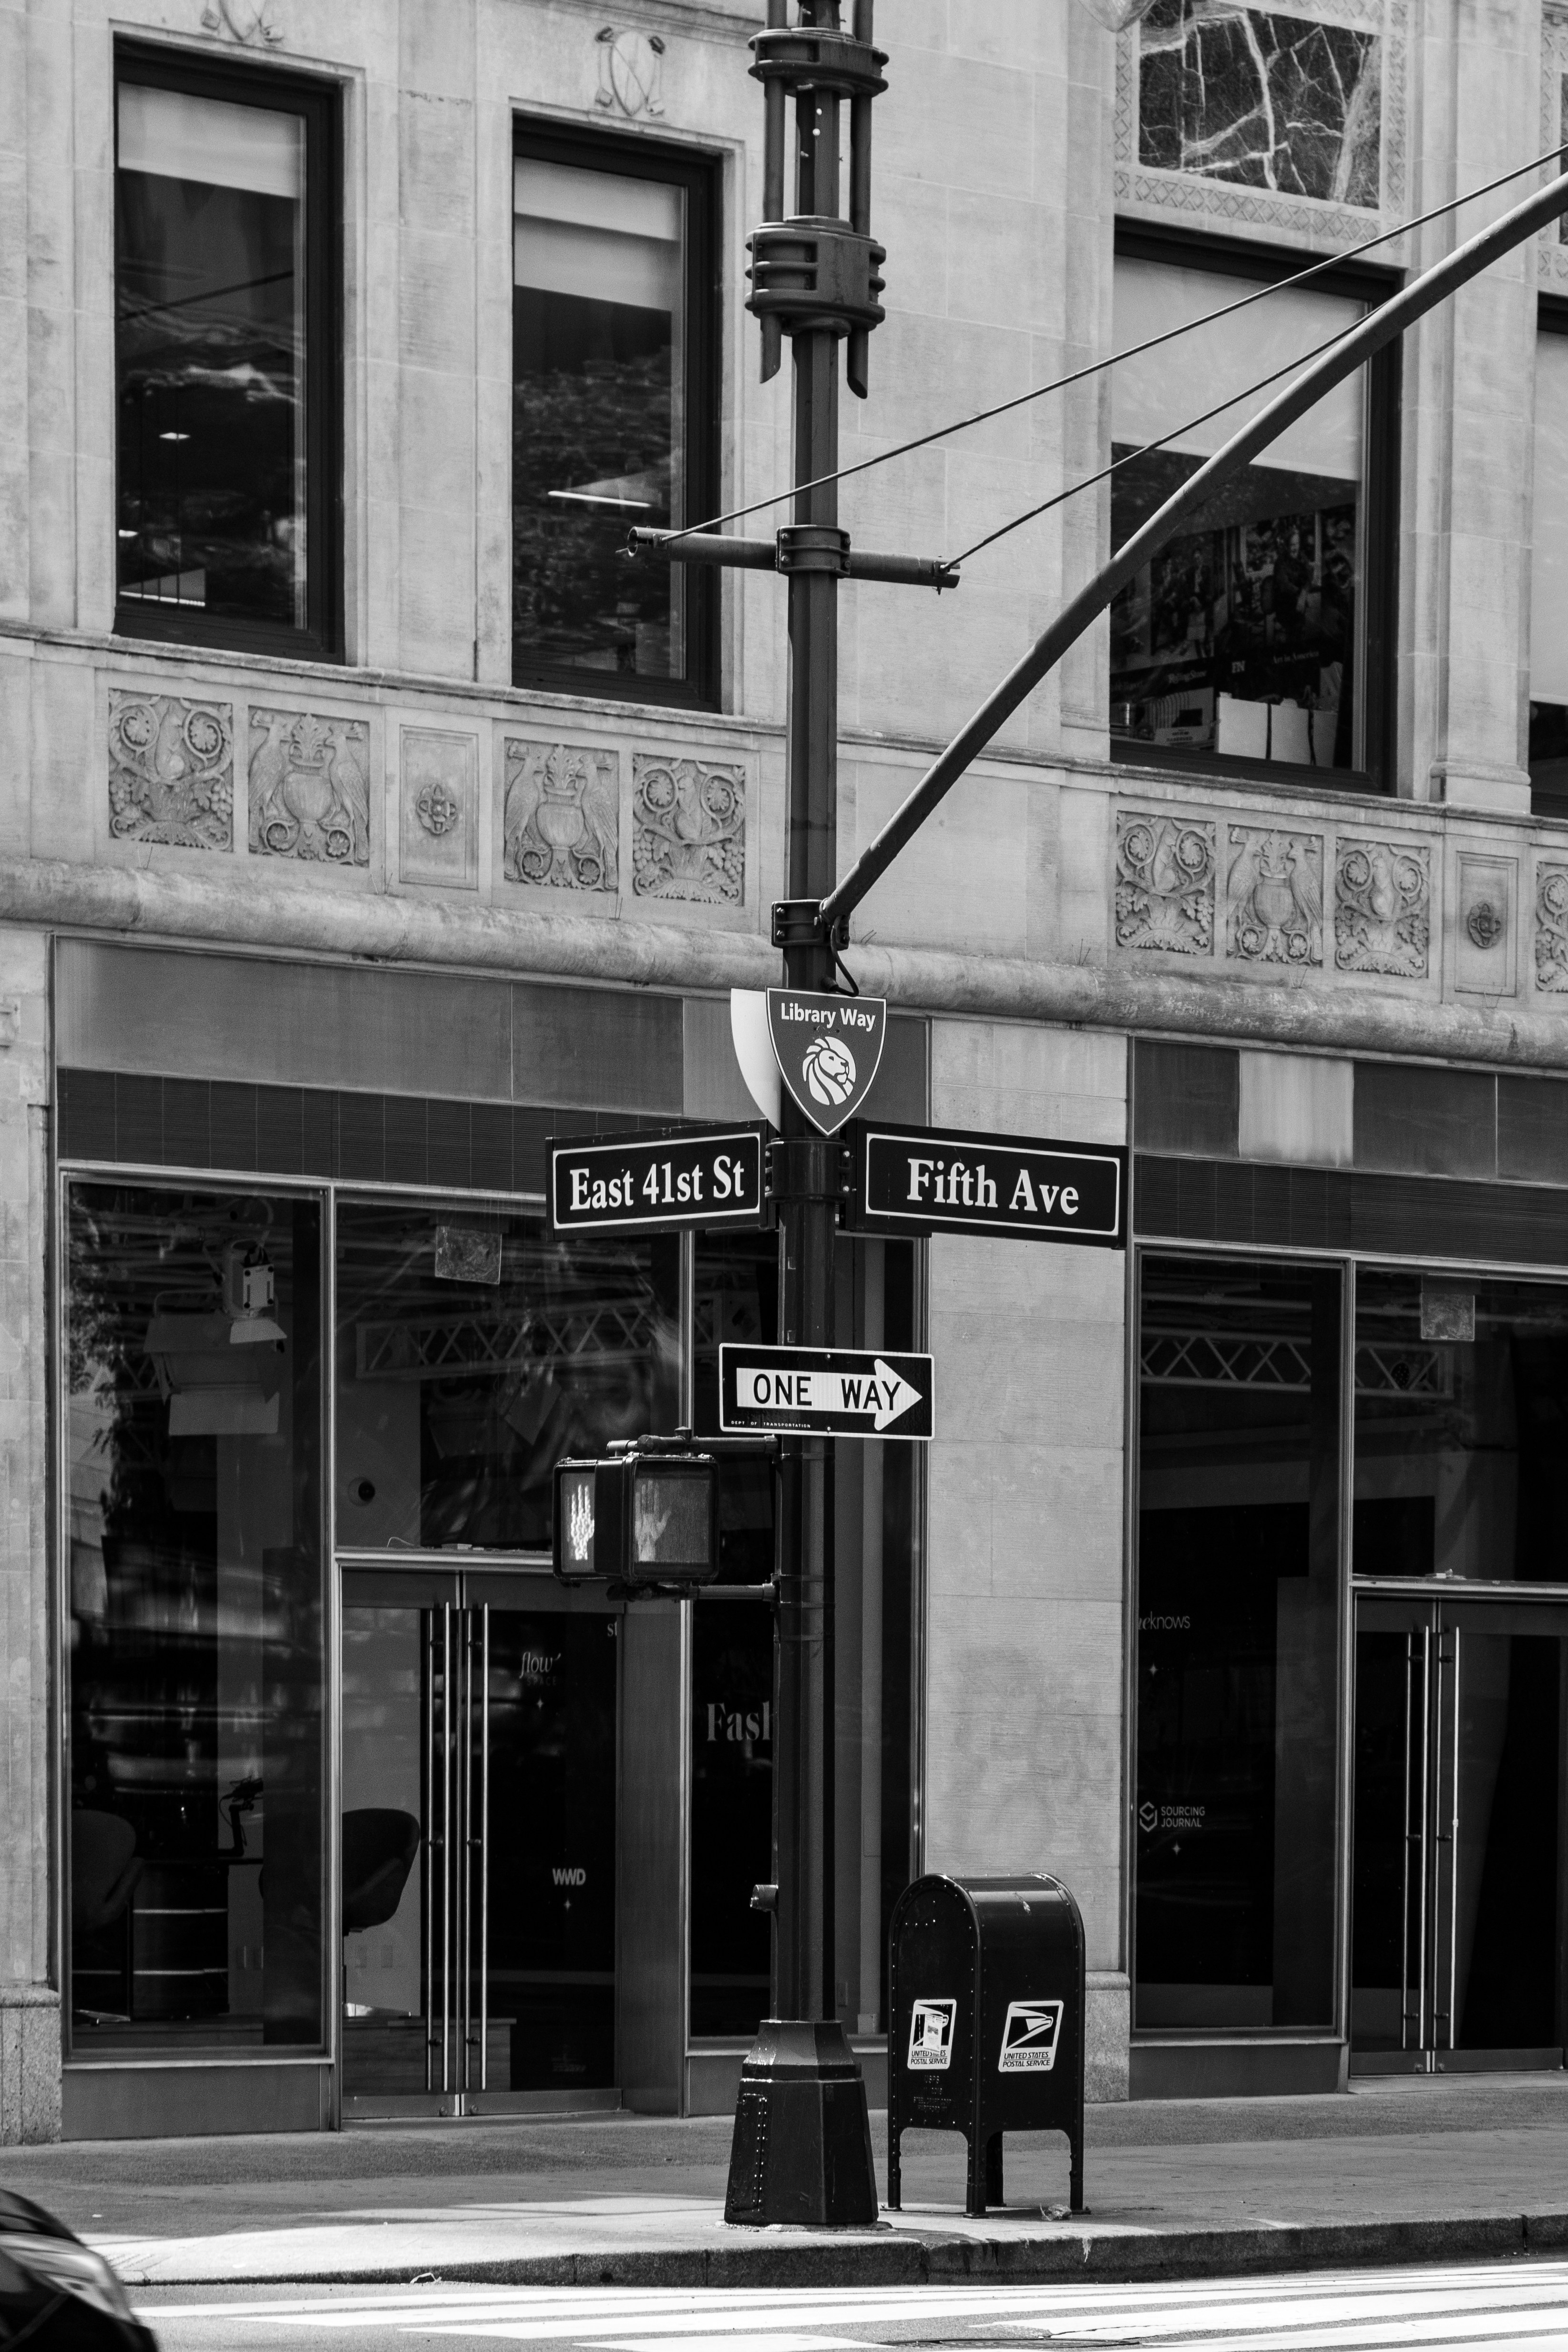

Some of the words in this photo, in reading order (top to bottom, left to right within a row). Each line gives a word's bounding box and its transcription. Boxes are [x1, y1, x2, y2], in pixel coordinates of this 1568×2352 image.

[781, 1002, 836, 1029] Library
[840, 1008, 876, 1032] Way
[570, 1168, 634, 1210] East
[643, 1162, 703, 1205] 41st
[713, 1155, 744, 1199] St
[907, 1158, 998, 1208] Fifth
[1009, 1169, 1079, 1215] Ave
[753, 1373, 812, 1406] ONE
[841, 1378, 902, 1411] WAY
[519, 1651, 562, 1679] flow
[527, 1676, 557, 1687] SPACE
[1161, 1806, 1205, 1816] SOURCING
[1161, 1818, 1201, 1827] JOURNAL
[553, 1868, 586, 1885] WWD
